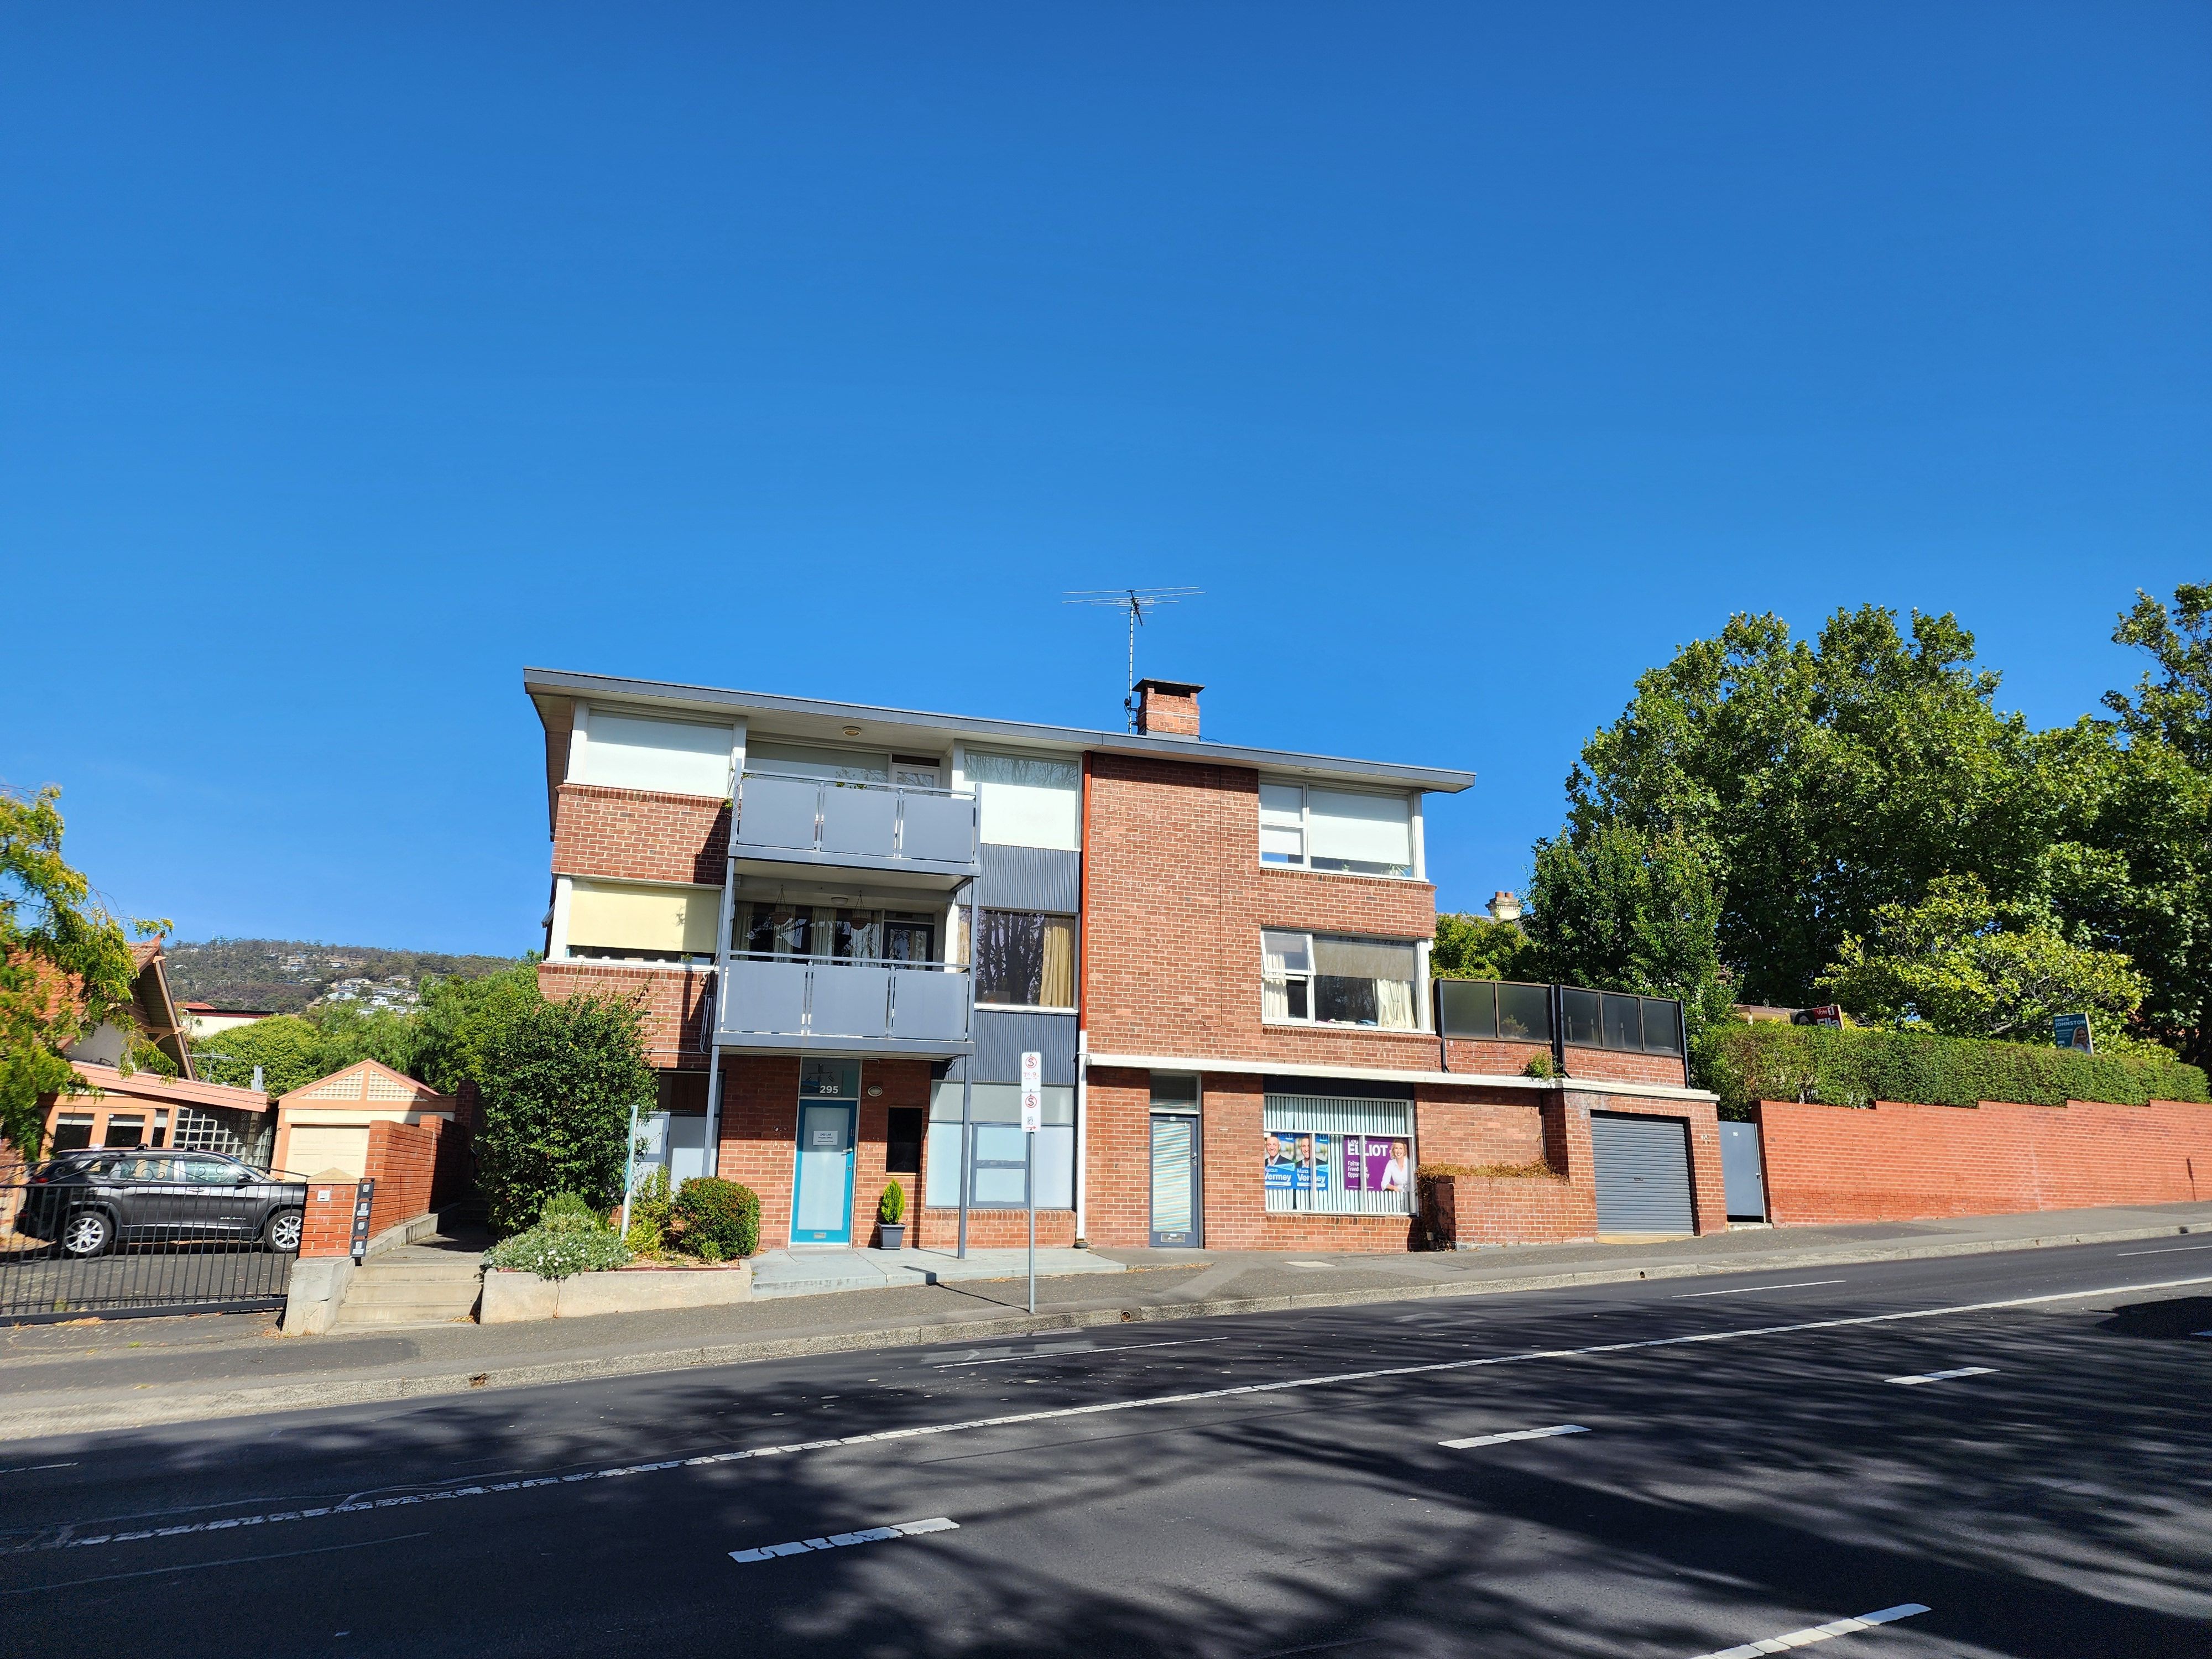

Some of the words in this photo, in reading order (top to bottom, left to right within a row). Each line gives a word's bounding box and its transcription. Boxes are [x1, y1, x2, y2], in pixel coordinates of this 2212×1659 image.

[1817, 1018, 1840, 1029] Ella
[2056, 1020, 2086, 1028] JOHNSTON
[820, 1086, 838, 1094] 295
[1297, 1173, 1326, 1183] Verey
